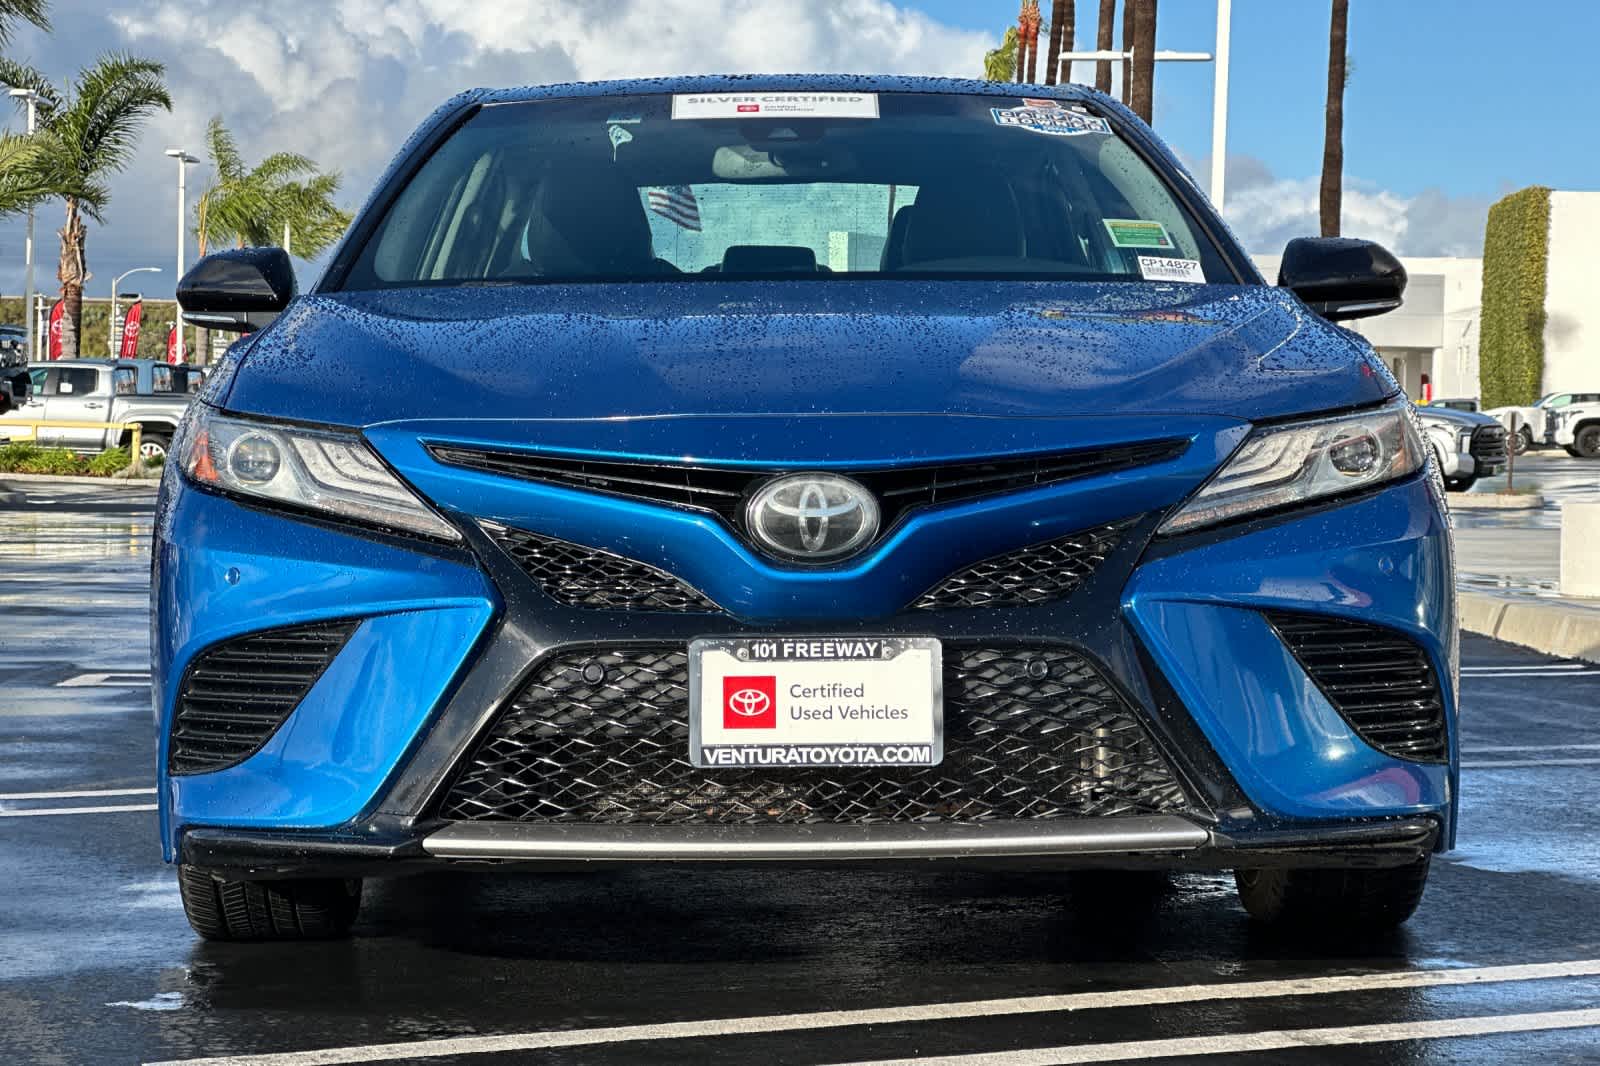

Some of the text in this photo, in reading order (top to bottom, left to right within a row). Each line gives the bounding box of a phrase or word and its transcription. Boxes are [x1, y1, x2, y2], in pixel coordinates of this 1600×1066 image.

[687, 95, 863, 104] SILVER CERTIFIED
[1141, 258, 1198, 270] CP14827
[751, 642, 879, 658] 101 FREEWAY
[789, 683, 865, 698] Certified
[790, 705, 909, 720] Used Vehicles
[704, 746, 930, 764] VENTURATOYOTA.COM
